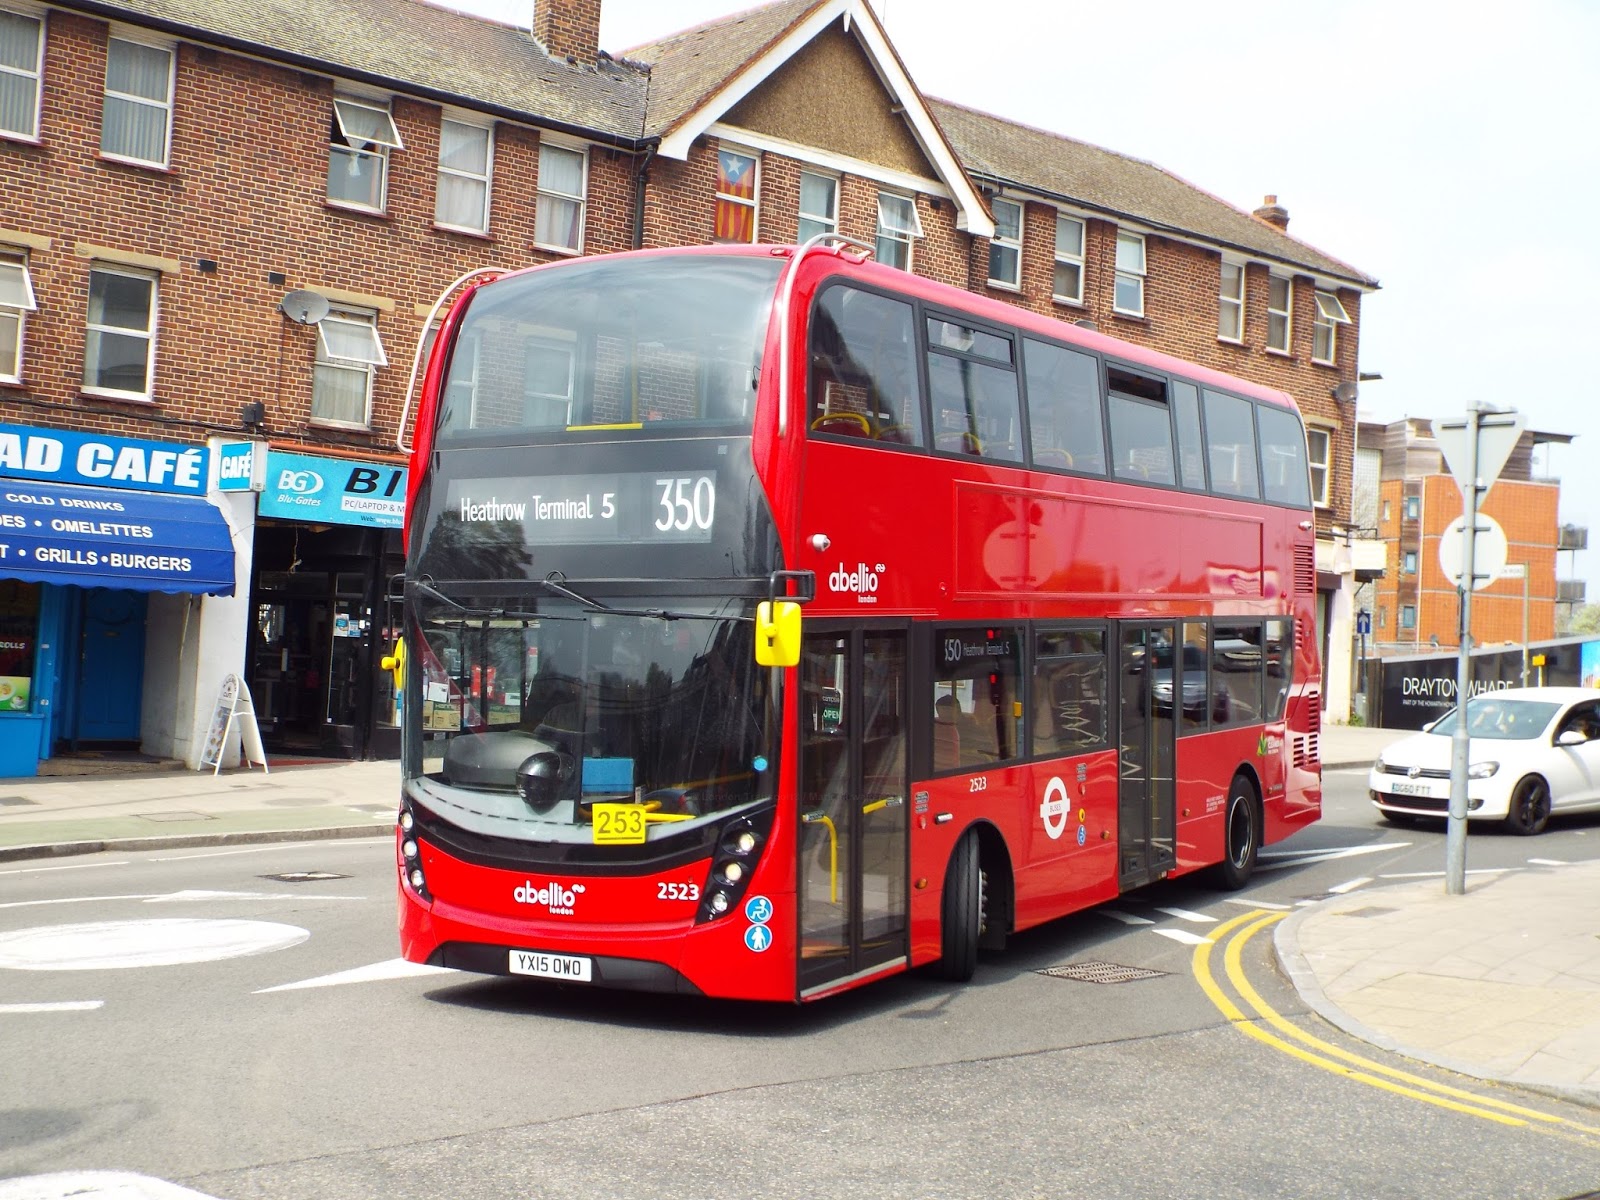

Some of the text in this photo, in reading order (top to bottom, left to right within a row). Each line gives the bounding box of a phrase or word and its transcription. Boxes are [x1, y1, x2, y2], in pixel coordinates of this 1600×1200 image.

[0, 433, 202, 488] AD CAFÉ
[221, 453, 252, 480] CAFÉ
[277, 470, 309, 491] BG
[344, 467, 402, 497] BI
[5, 493, 125, 512] COLD DRINKS
[277, 494, 322, 507] Blu-Gates
[345, 500, 387, 511] PC/LAPTOP
[461, 476, 716, 531] Heathrow Terminal 5 350
[51, 519, 153, 538] OMELETTES
[35, 547, 98, 565] GRILLS
[110, 553, 192, 572] BURGERS
[829, 561, 878, 593] abellio
[858, 595, 877, 603] london
[1402, 677, 1458, 697] DRAYTON
[969, 777, 987, 792] 2523
[598, 810, 643, 835] 253
[513, 880, 576, 907] abellio
[657, 882, 700, 900] 2523
[549, 905, 574, 915] london
[518, 954, 581, 976] YX15 OWO
